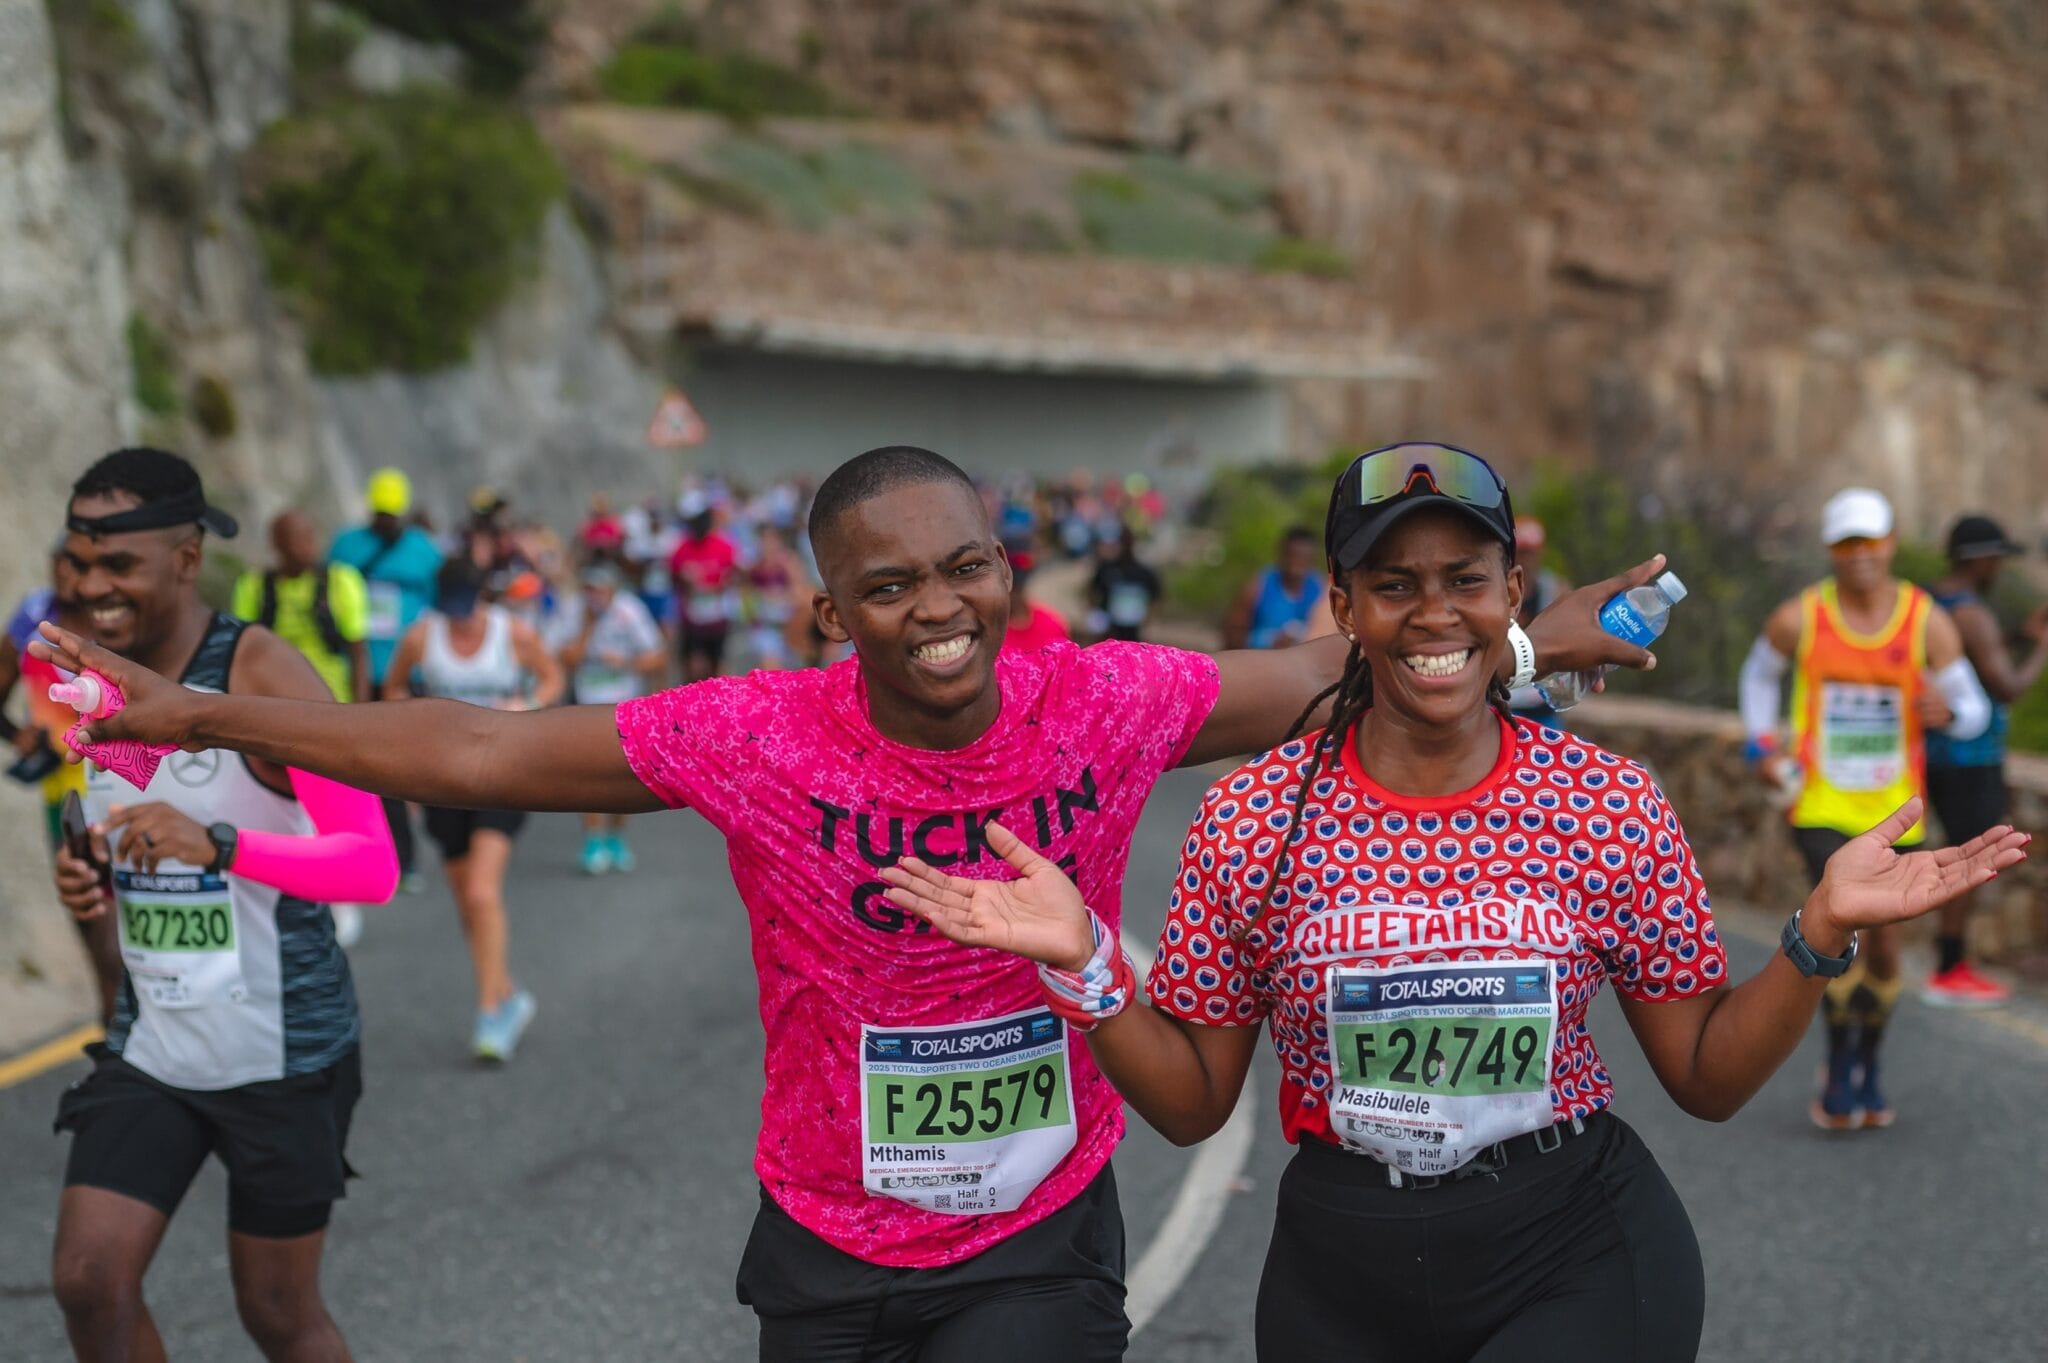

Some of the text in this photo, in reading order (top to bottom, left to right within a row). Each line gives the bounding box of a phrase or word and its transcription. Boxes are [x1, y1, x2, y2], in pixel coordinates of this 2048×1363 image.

[808, 765, 1100, 868] TUCK IN
[1303, 901, 1570, 959] CHEETAHS AC
[1380, 976, 1506, 1001] TOTALSPORTS
[1361, 1008, 1430, 1022] TOTALSPORTS
[1431, 1007, 1455, 1016] TWO
[1457, 1007, 1496, 1016] OCEANS
[1498, 1006, 1551, 1016] MARATHON
[911, 1026, 1023, 1056] TOTALSPORTS
[868, 1042, 1062, 1074] 2025 TOTALSPORTS TWO OCEANS MARATHON
[1338, 1087, 1430, 1115] Masibulele
[1335, 1110, 1361, 1120] MEDICAL
[1361, 1114, 1397, 1124] EMERGENCY
[1398, 1118, 1425, 1128] NUMBER
[870, 1145, 946, 1163] Mthamis
[1419, 1148, 1441, 1159] Half
[1419, 1161, 1446, 1172] Ultra
[957, 1189, 979, 1199] Half
[958, 1199, 997, 1210] Ultra 2
